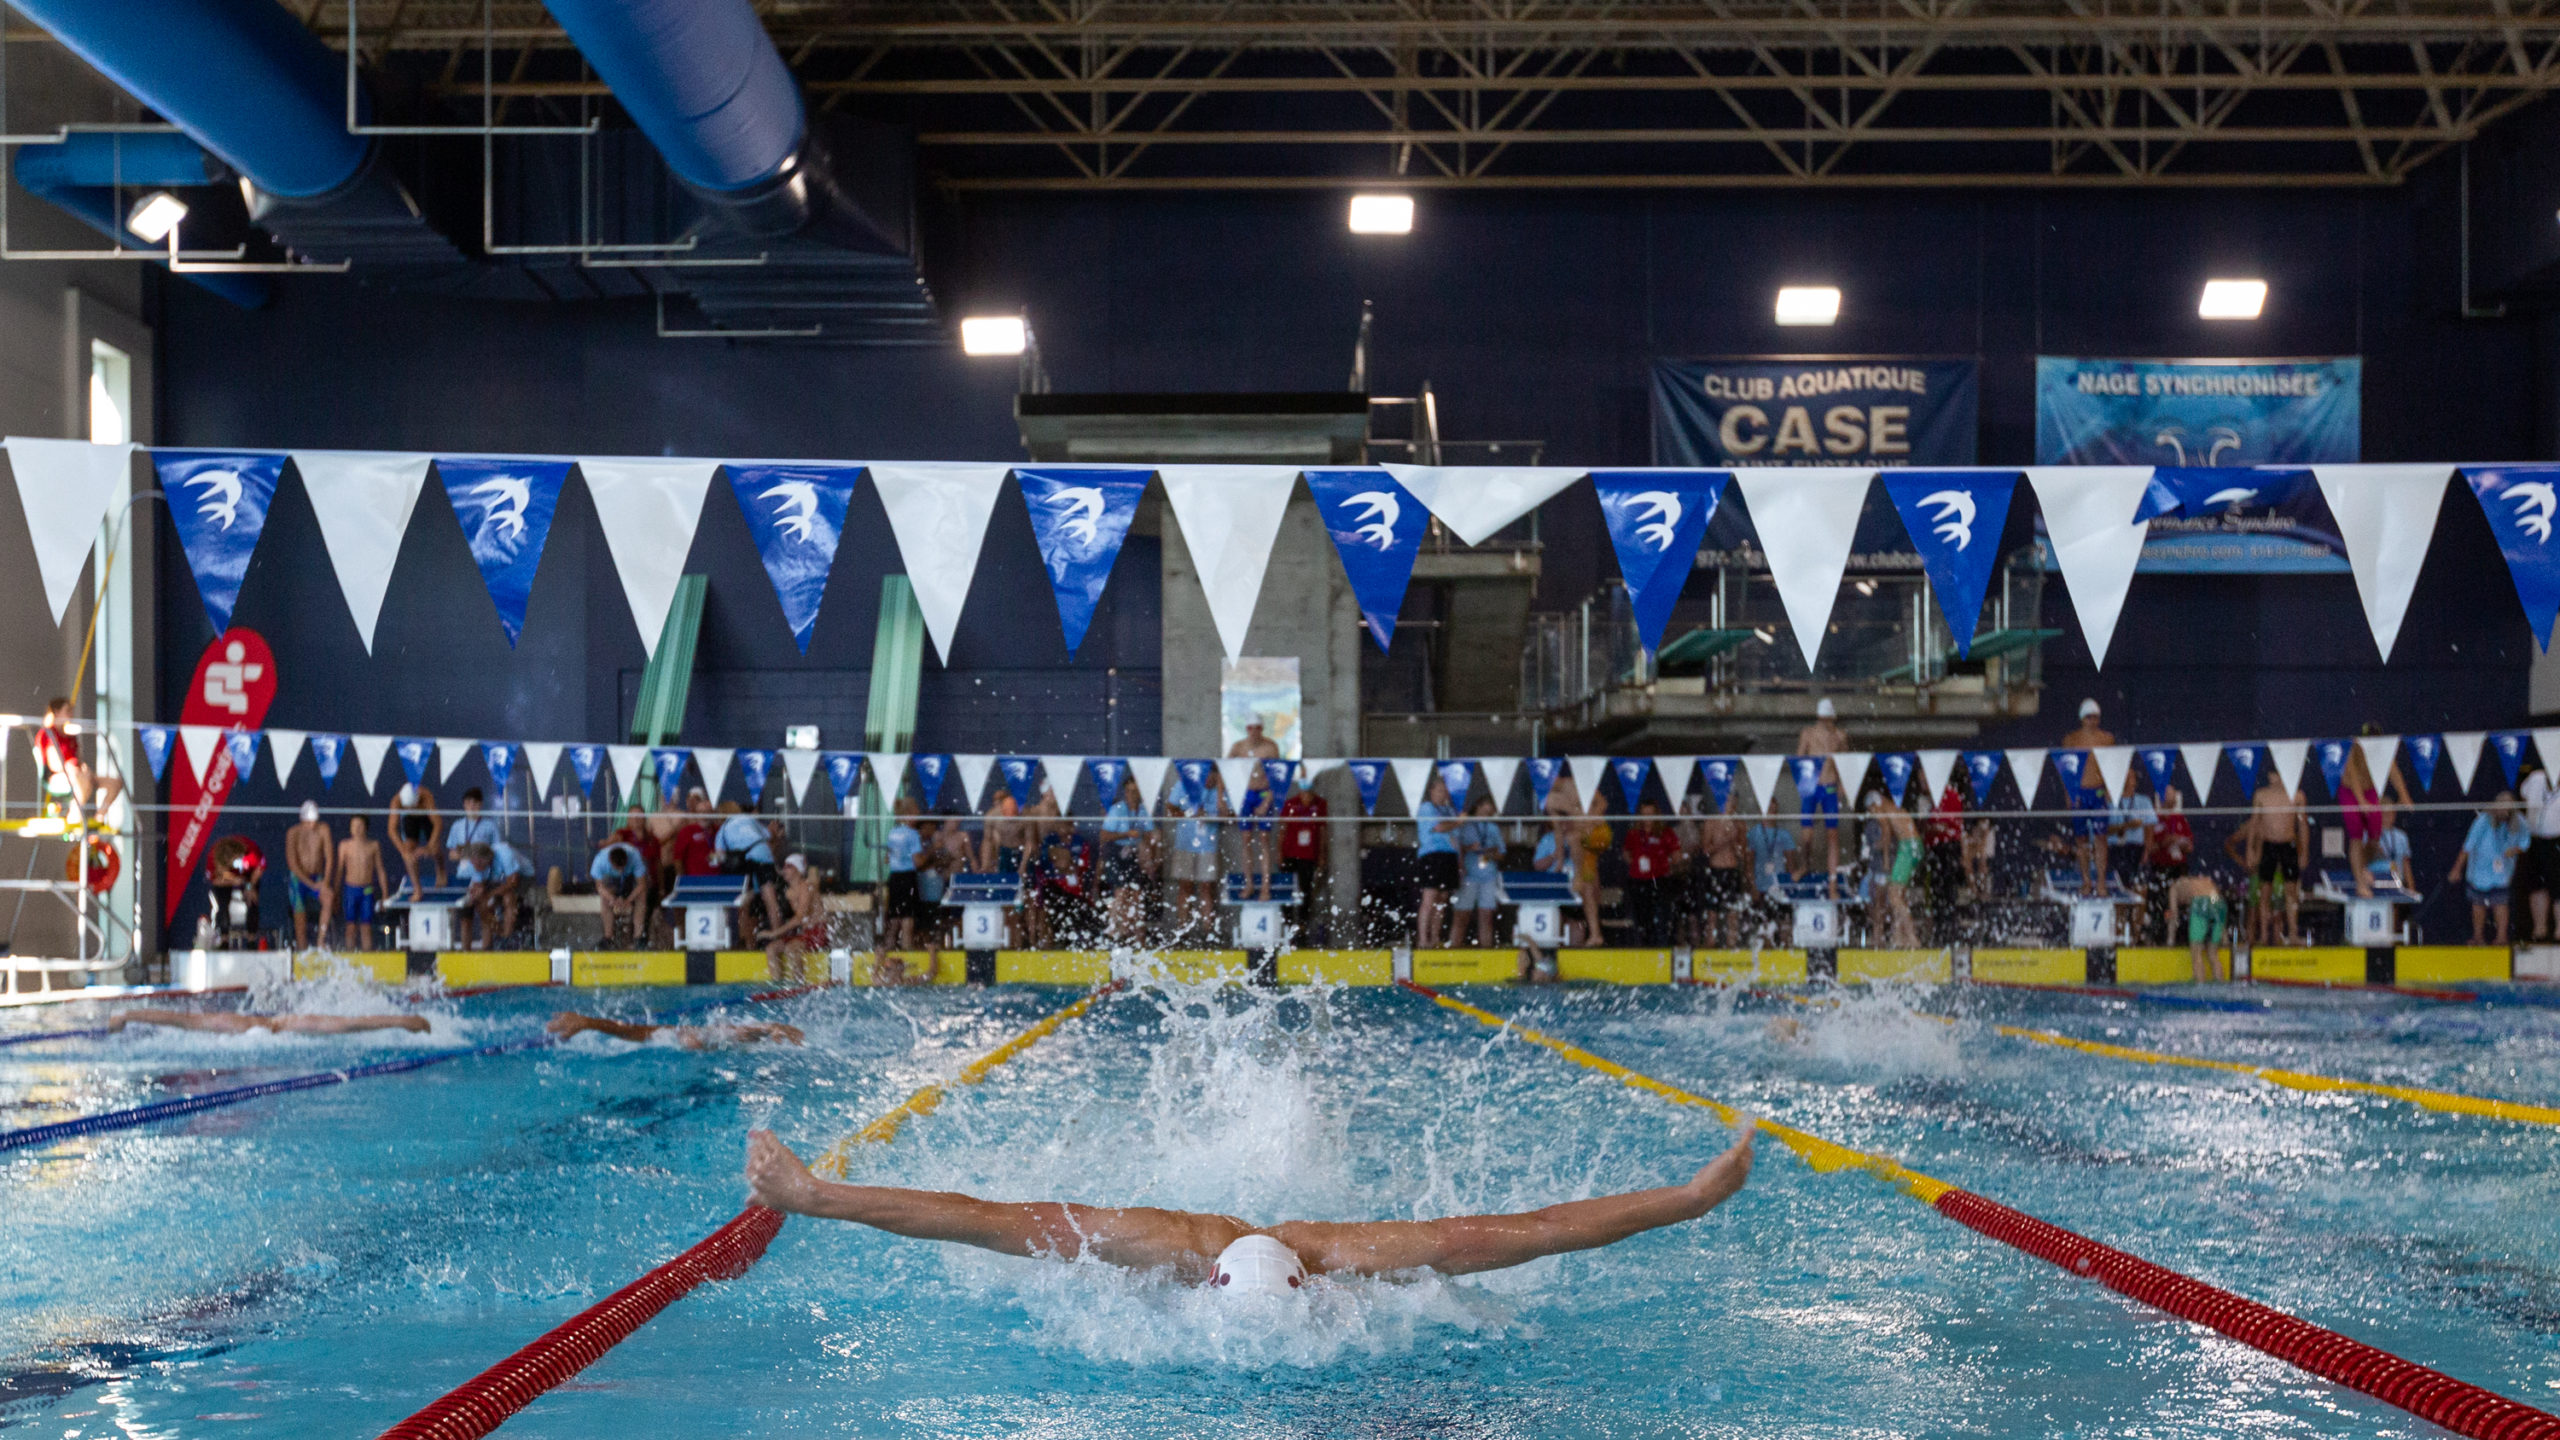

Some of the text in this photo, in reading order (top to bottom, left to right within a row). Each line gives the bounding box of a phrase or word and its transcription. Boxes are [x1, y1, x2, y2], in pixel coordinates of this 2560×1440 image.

[1704, 366, 1926, 400] CLUB AQUATIQUE
[2077, 372, 2140, 396] NAGE
[1719, 404, 1911, 455] CASE
[176, 818, 201, 868] JEUX
[195, 791, 213, 822] DU
[423, 917, 430, 937] 1
[698, 916, 711, 936] 2
[977, 915, 989, 935] 3
[1256, 916, 1268, 933] 4
[1535, 914, 1547, 933] 5
[1813, 914, 1825, 933] 6
[2091, 913, 2102, 933] 7
[2369, 911, 2381, 931] 8
